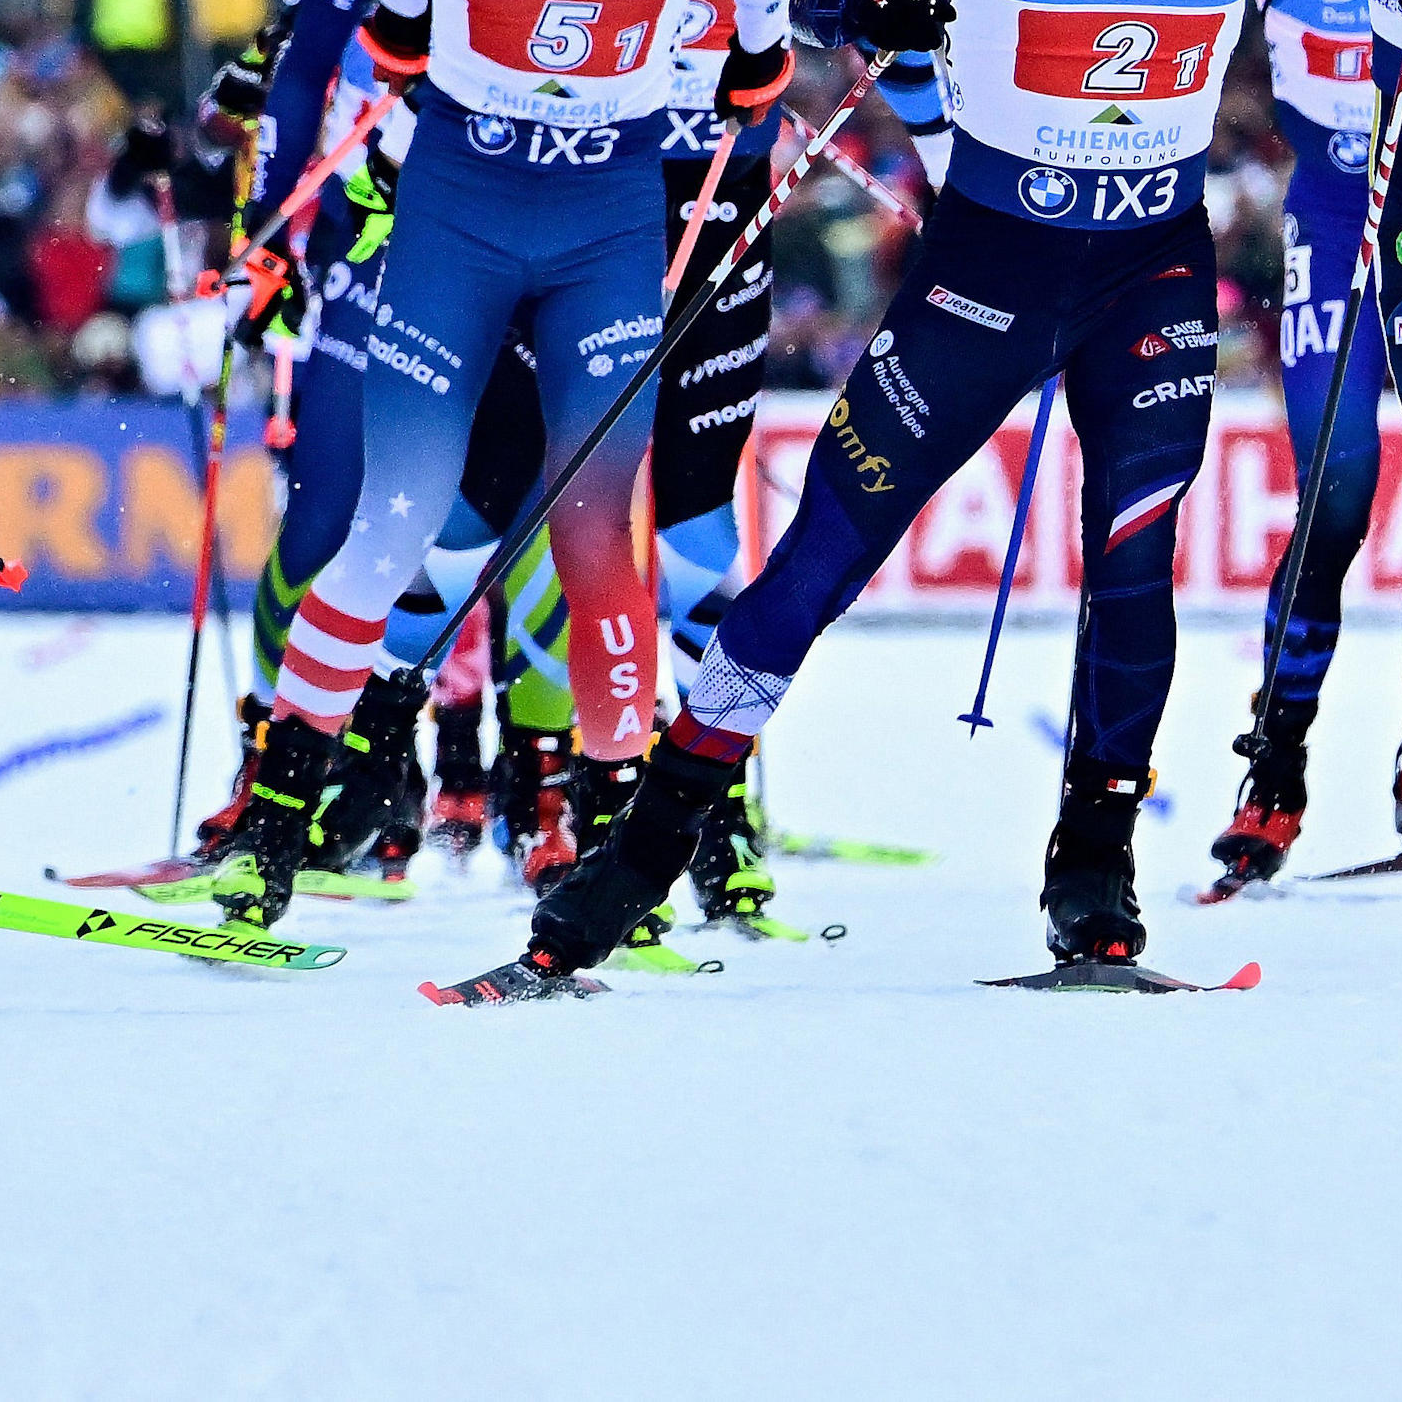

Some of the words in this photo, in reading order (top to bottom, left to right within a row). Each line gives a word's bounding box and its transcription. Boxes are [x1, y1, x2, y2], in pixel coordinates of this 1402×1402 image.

[527, 0, 602, 72] 5
[614, 20, 649, 73] 1
[1082, 21, 1158, 94] 2
[1173, 42, 1204, 90] 1
[528, 124, 621, 165] iX3
[1033, 148, 1177, 166] RUHPOLDING
[1036, 126, 1181, 149] CHIEMGAU
[1093, 169, 1179, 221] iX3
[946, 296, 978, 316] Jean
[979, 310, 1010, 327] Lain
[1161, 320, 1205, 338] CAISSE
[393, 320, 463, 369] ARIENS
[829, 397, 895, 493] omfy
[600, 614, 643, 742] USA
[124, 922, 304, 965] FISCHER
